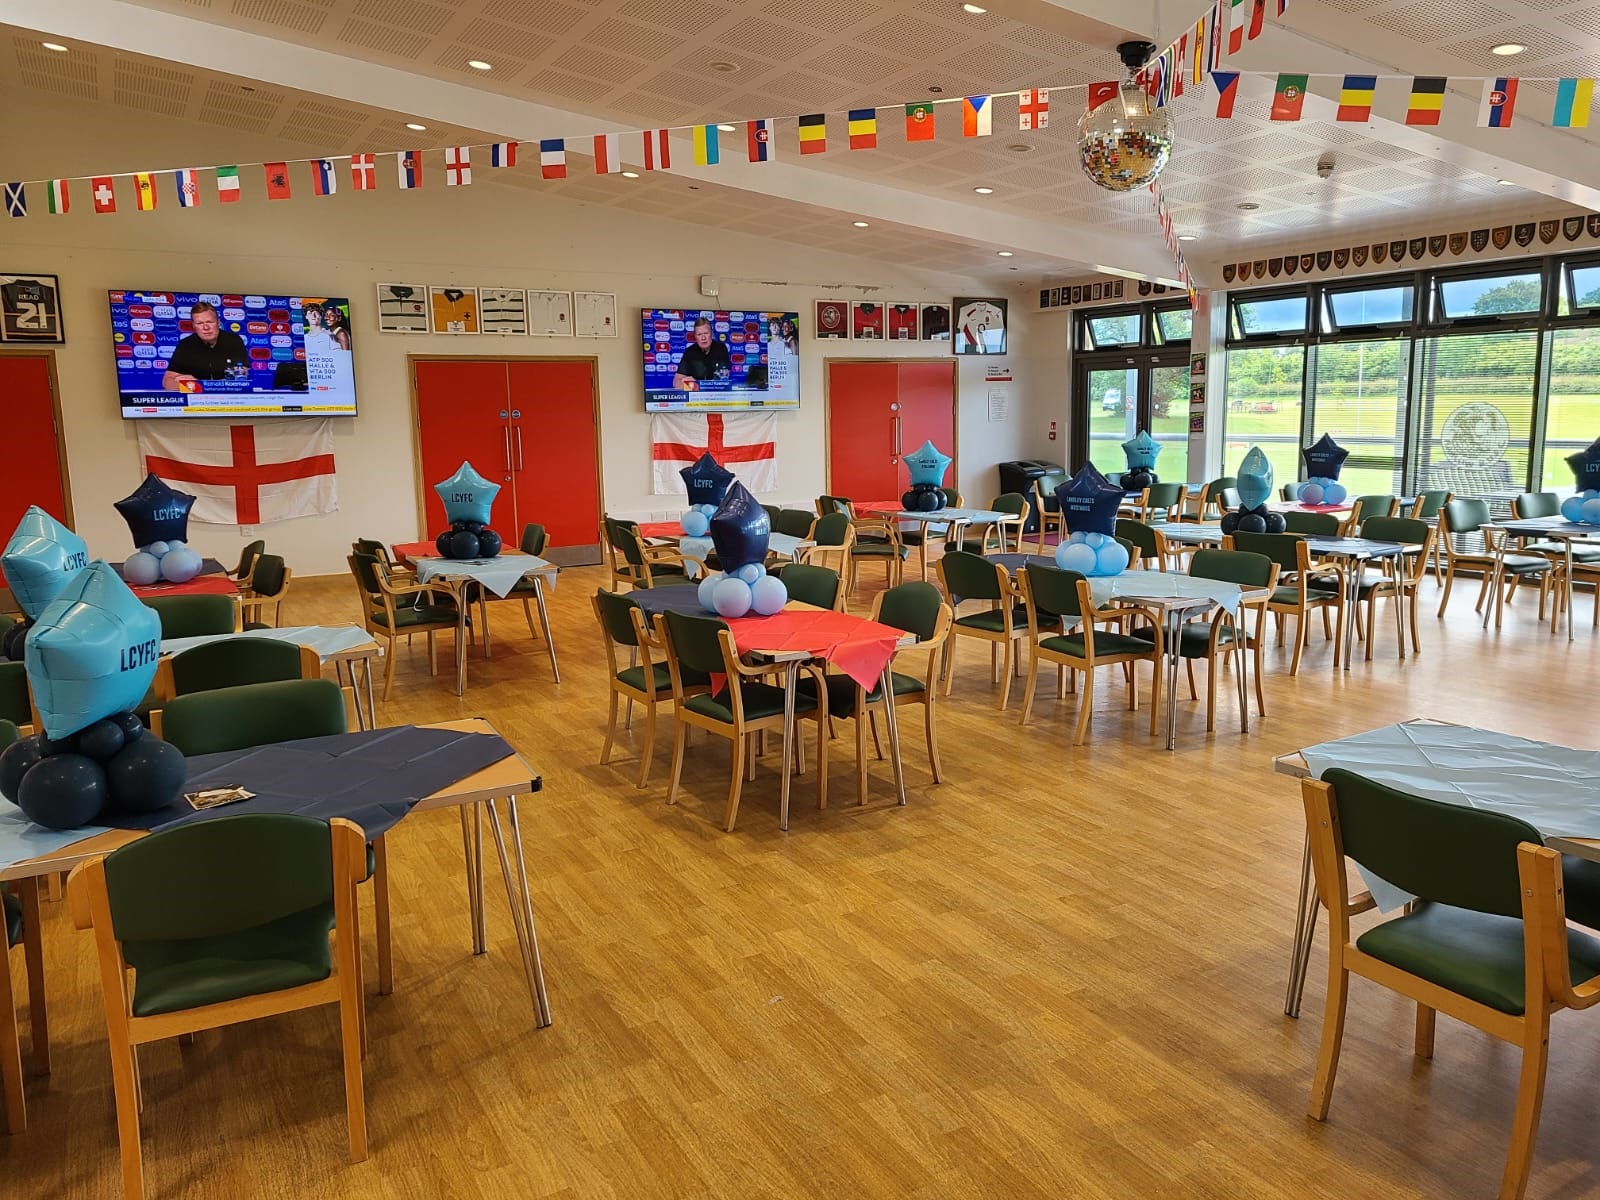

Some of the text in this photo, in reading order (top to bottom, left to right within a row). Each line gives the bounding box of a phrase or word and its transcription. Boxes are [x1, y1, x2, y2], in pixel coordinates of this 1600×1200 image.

[16, 302, 47, 328] 21
[694, 478, 712, 488] LCYFC
[452, 493, 472, 502] LCYFC
[154, 508, 180, 520] LCYFC
[64, 552, 87, 572] LCYFC
[120, 638, 156, 672] LCYFC
